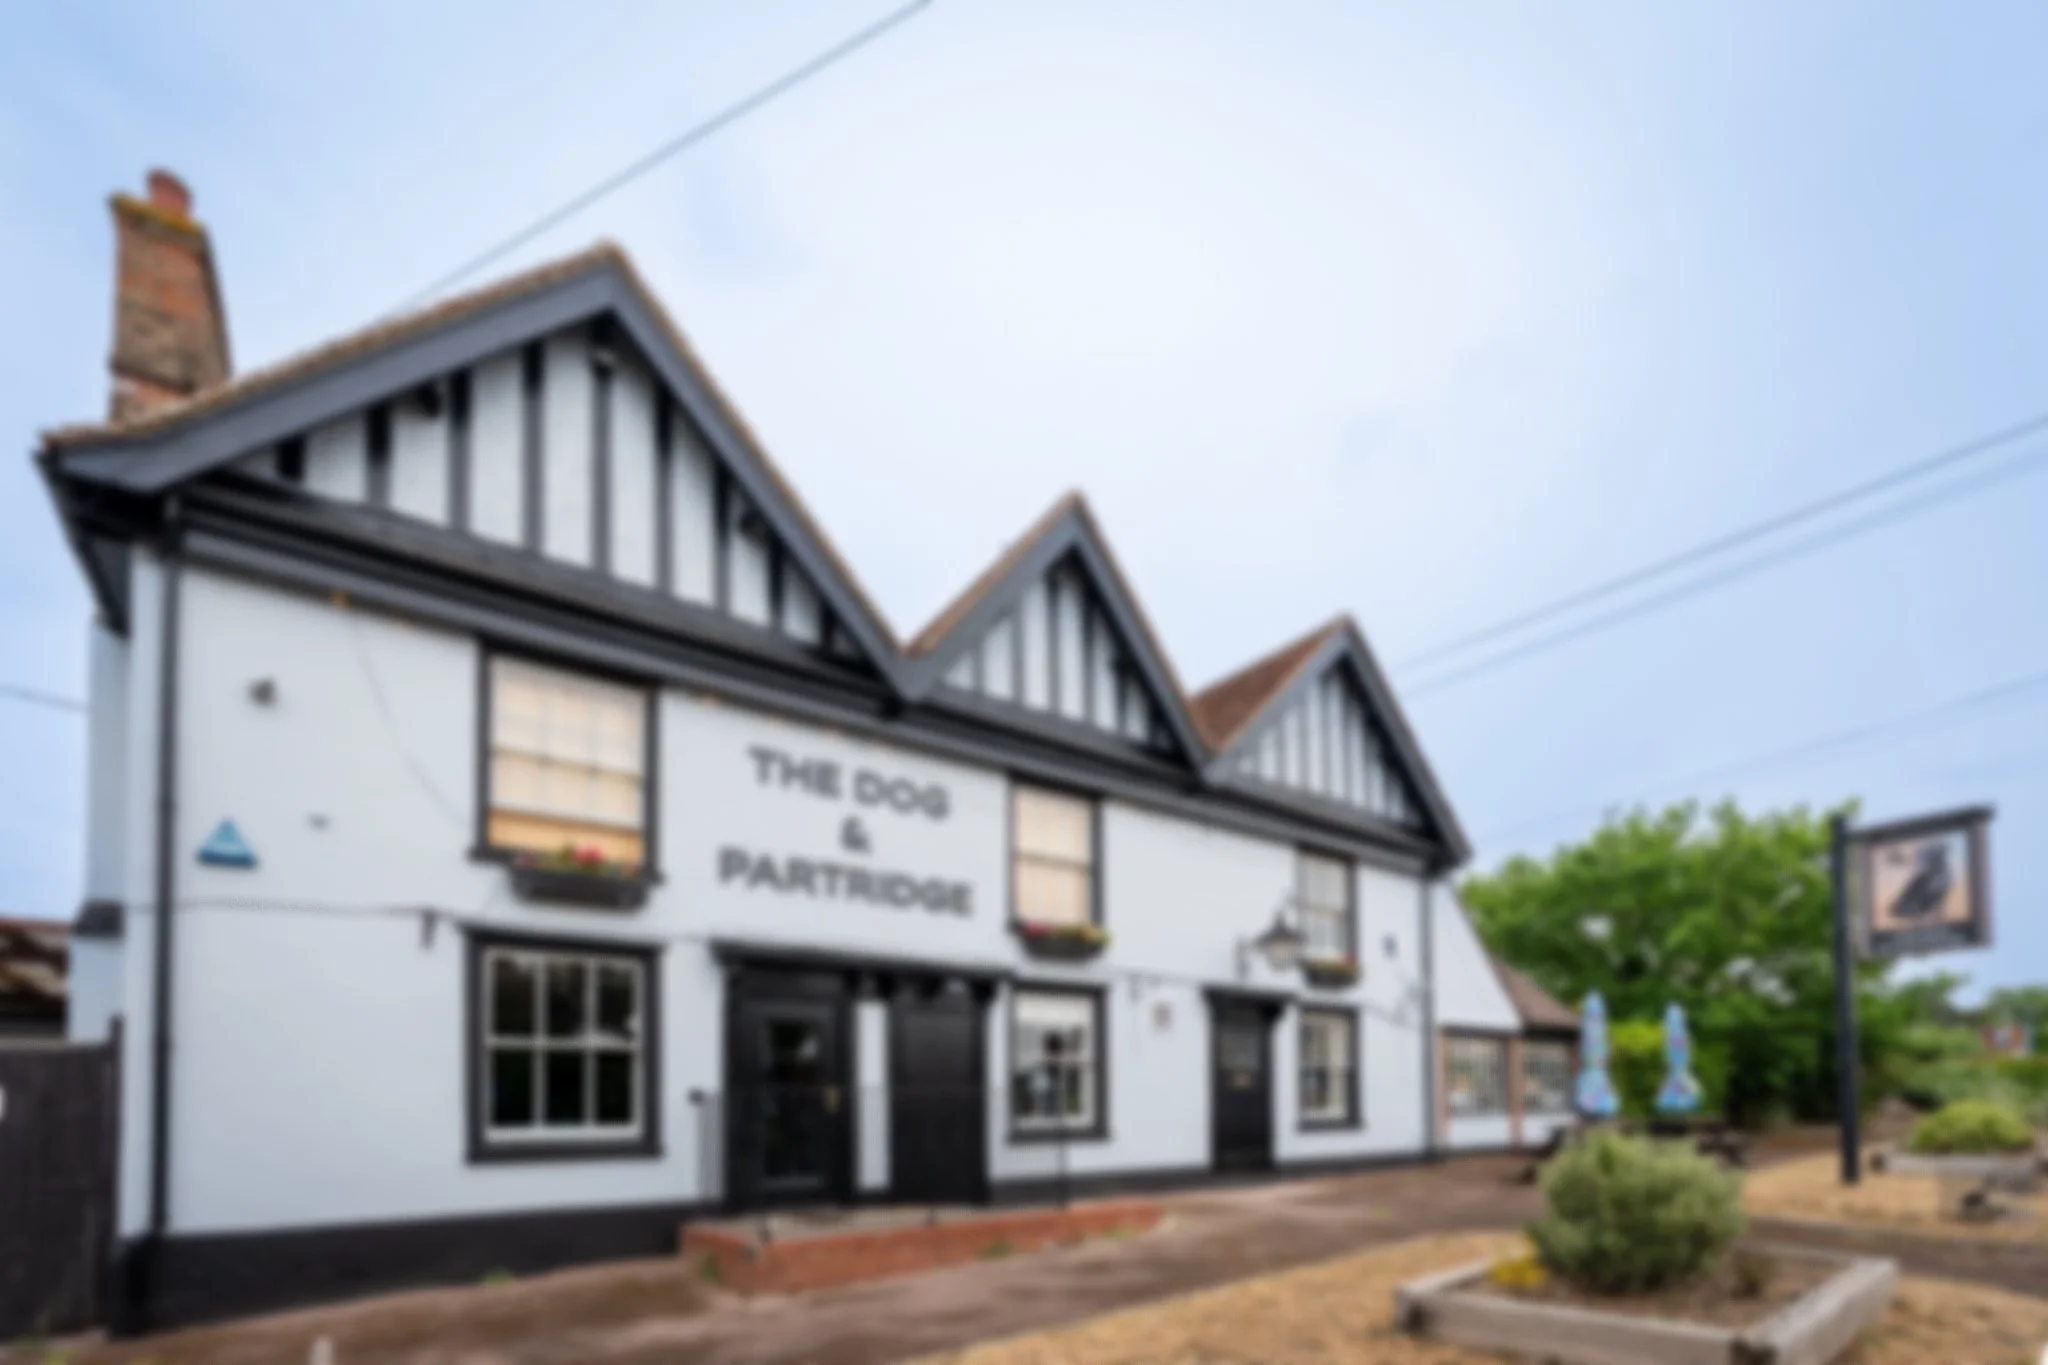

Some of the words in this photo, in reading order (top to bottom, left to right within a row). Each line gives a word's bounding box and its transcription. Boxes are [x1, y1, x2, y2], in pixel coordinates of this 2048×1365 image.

[748, 747, 840, 800] THE
[854, 768, 949, 820] DOG
[840, 814, 871, 853] &
[718, 847, 974, 917] PARTRIDGE
